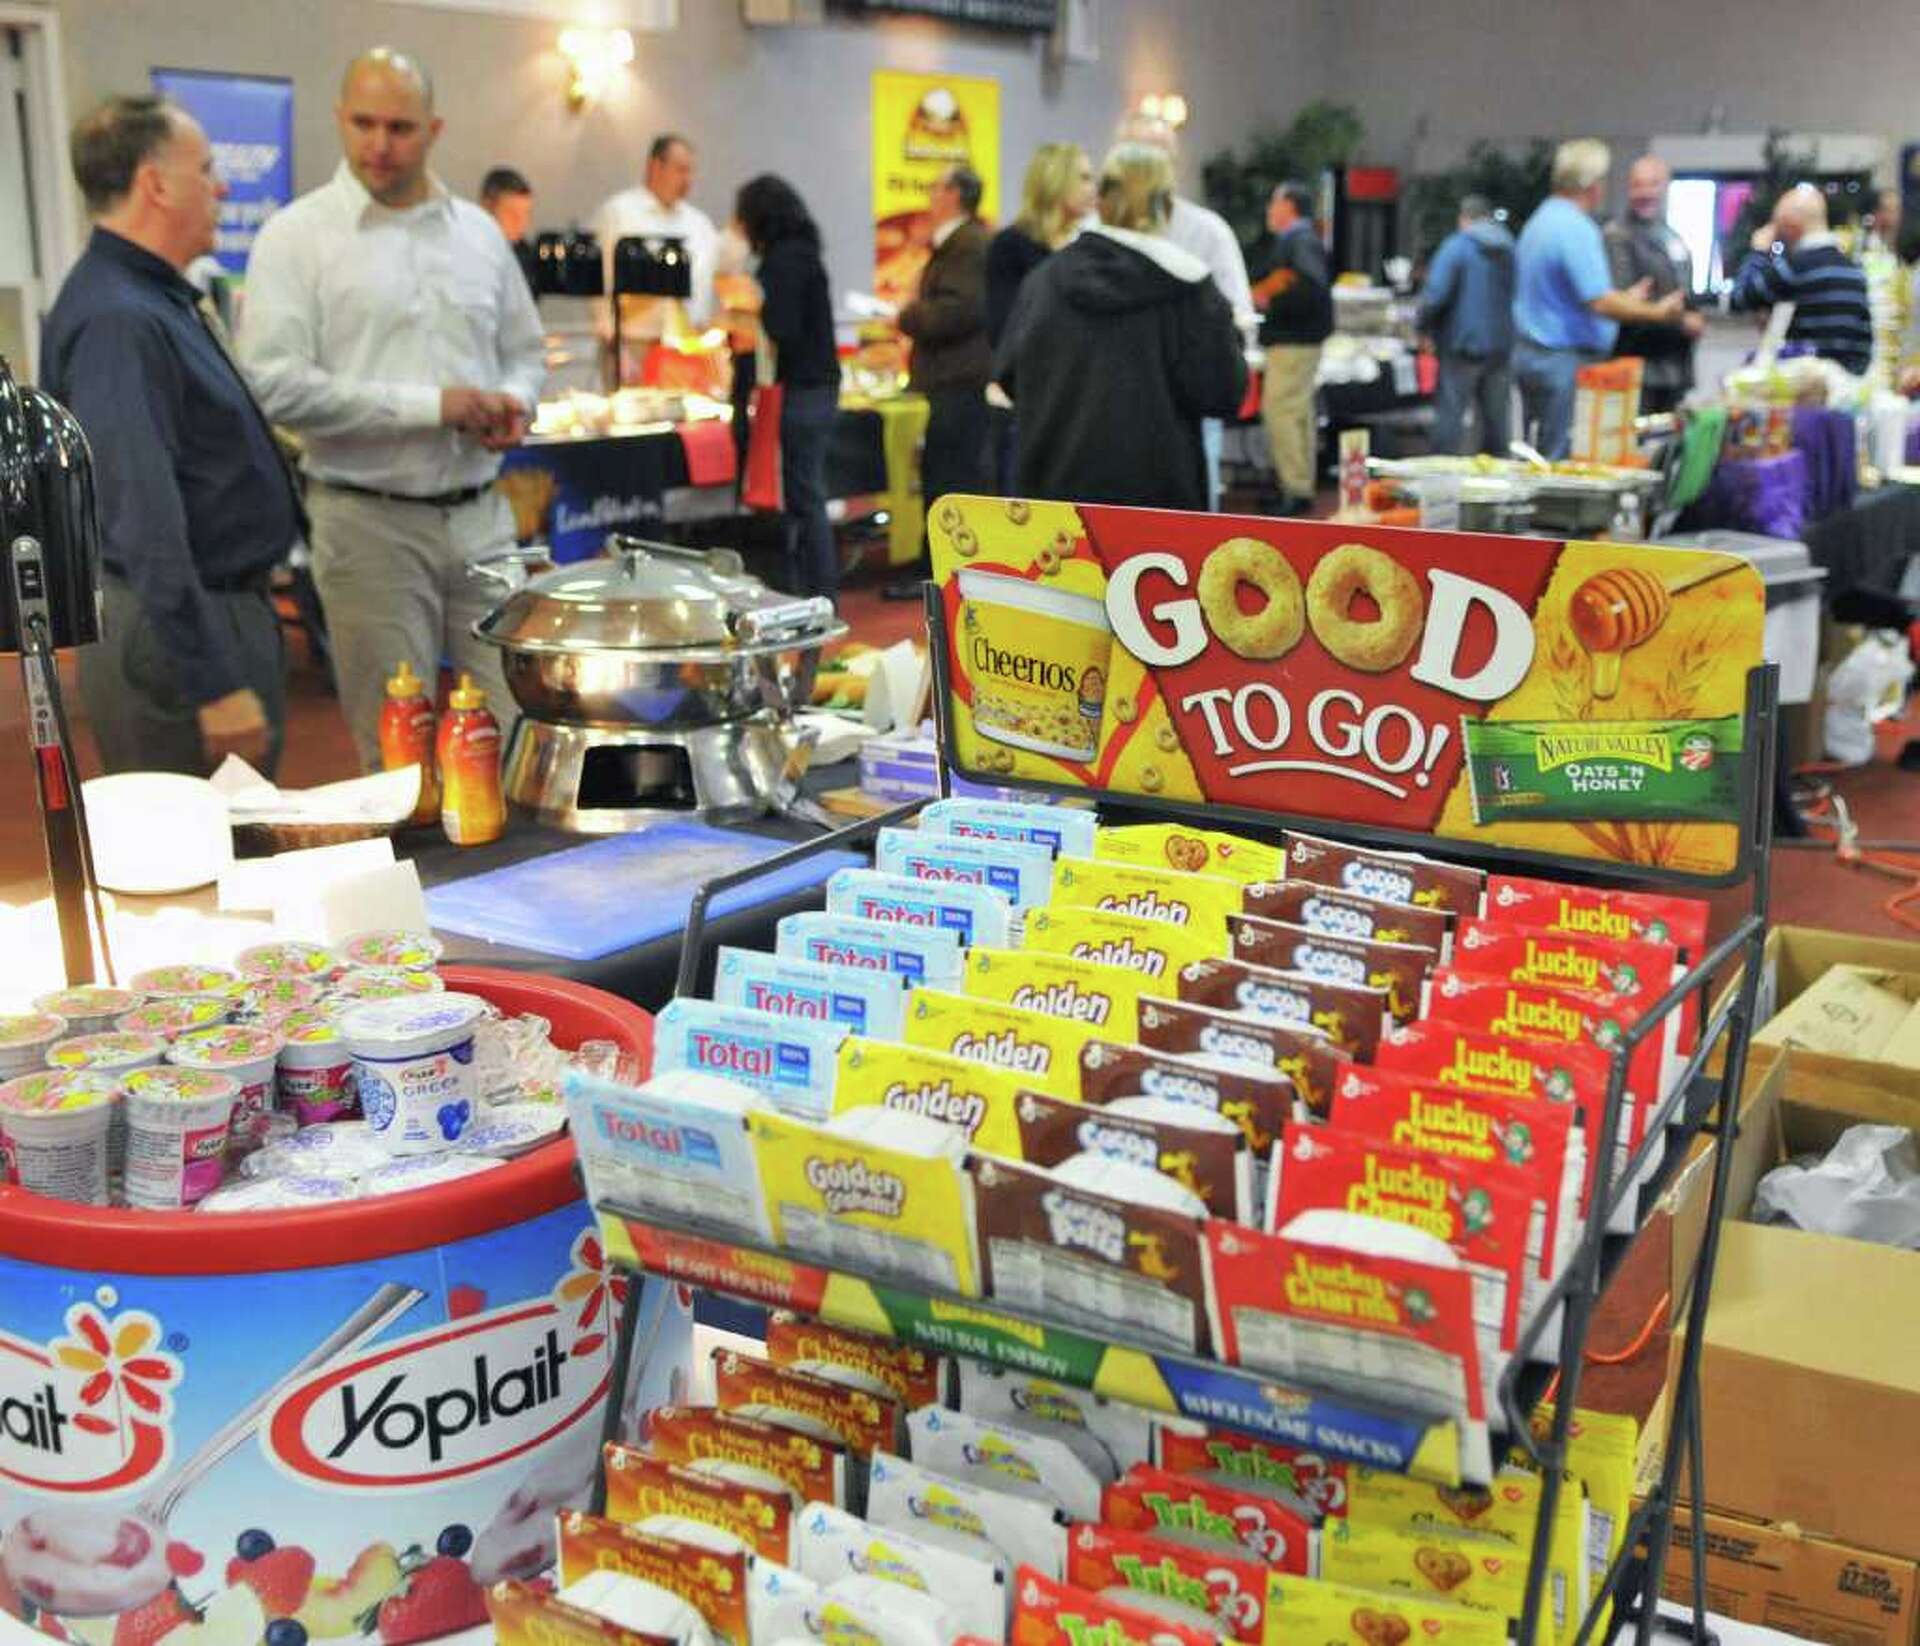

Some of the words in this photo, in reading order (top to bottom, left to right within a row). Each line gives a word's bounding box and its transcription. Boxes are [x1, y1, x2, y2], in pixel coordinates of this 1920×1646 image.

[1106, 537, 1535, 702] GOOD
[973, 636, 1076, 692] Cheerios
[1183, 683, 1292, 760] TO
[1306, 688, 1450, 788] GO!
[1564, 763, 1618, 778] OATS
[1572, 778, 1643, 792] HONEY
[1559, 898, 1630, 941] Lucky
[1525, 939, 1599, 988] Lucky
[1011, 980, 1111, 1026] Golden
[1505, 990, 1581, 1041] Lucky
[693, 1034, 772, 1076] Total
[952, 1028, 1052, 1074] Golden
[1454, 1037, 1532, 1091] Lucky
[884, 1078, 988, 1124] Golden
[1409, 1091, 1489, 1142] Lucky
[602, 1110, 682, 1154] Total
[805, 1156, 907, 1202] Golden
[1364, 1152, 1447, 1210] Lucky
[1293, 1252, 1387, 1300] Lucky
[0, 1384, 67, 1455] ait
[326, 1329, 568, 1462] Yoplait
